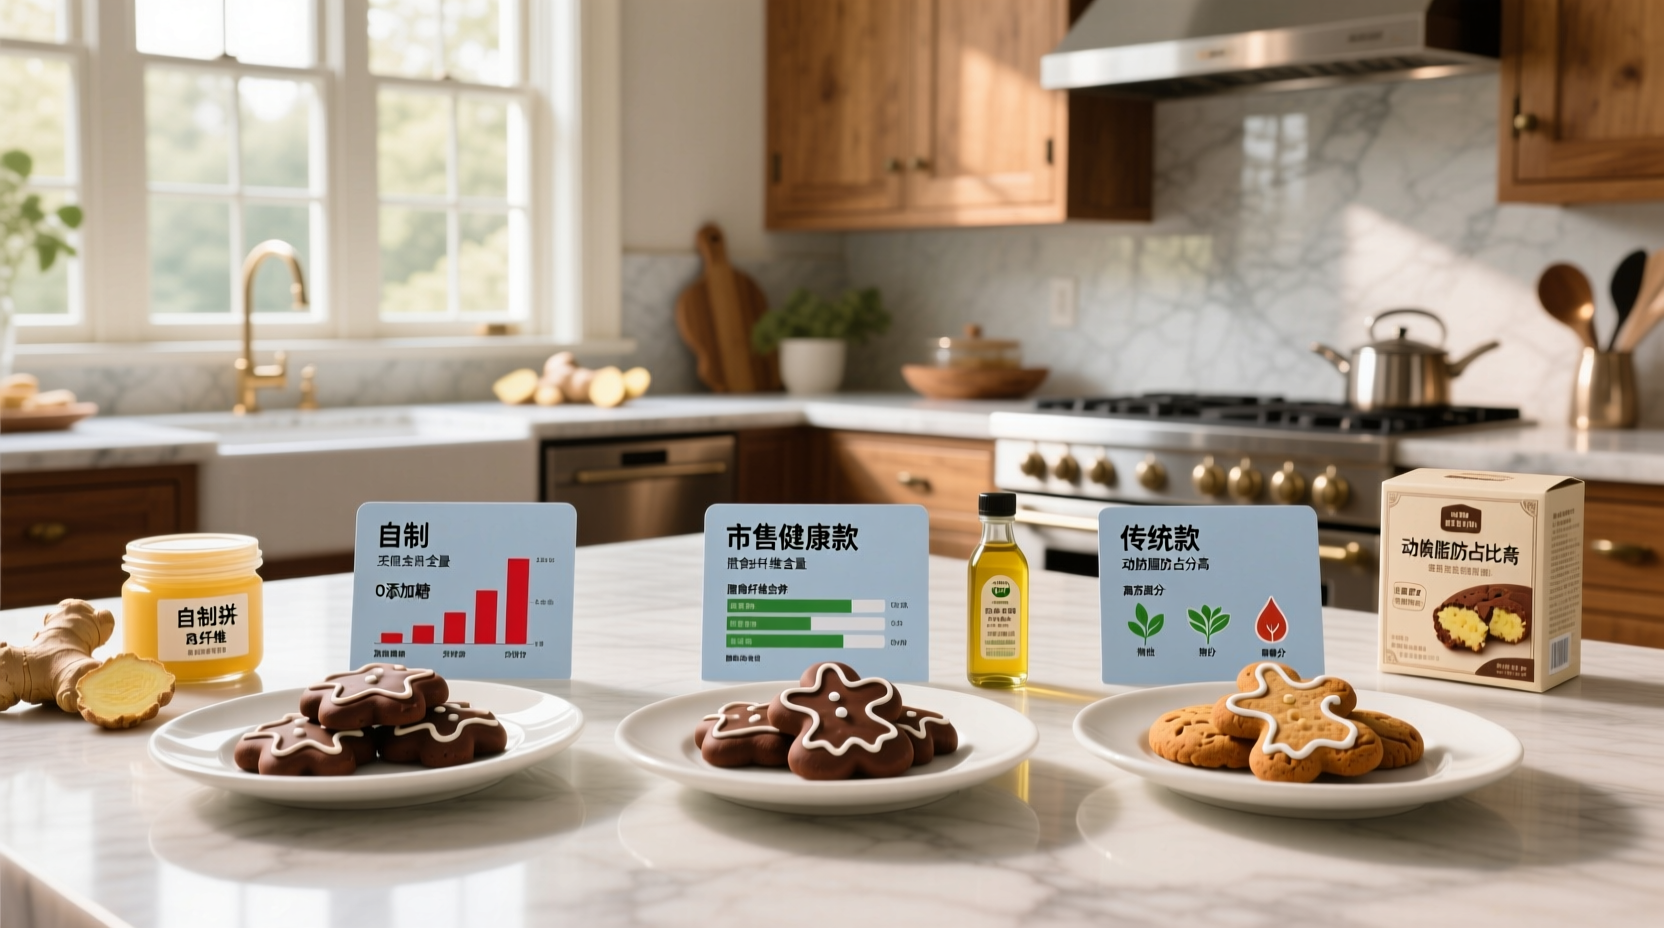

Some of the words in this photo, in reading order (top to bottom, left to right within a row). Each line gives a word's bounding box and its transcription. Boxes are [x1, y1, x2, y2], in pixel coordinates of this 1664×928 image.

[379, 521, 429, 549] 自制
[726, 522, 859, 551] 市售健康款
[1120, 524, 1200, 552] 传统款
[375, 582, 431, 600] 0添加糖
